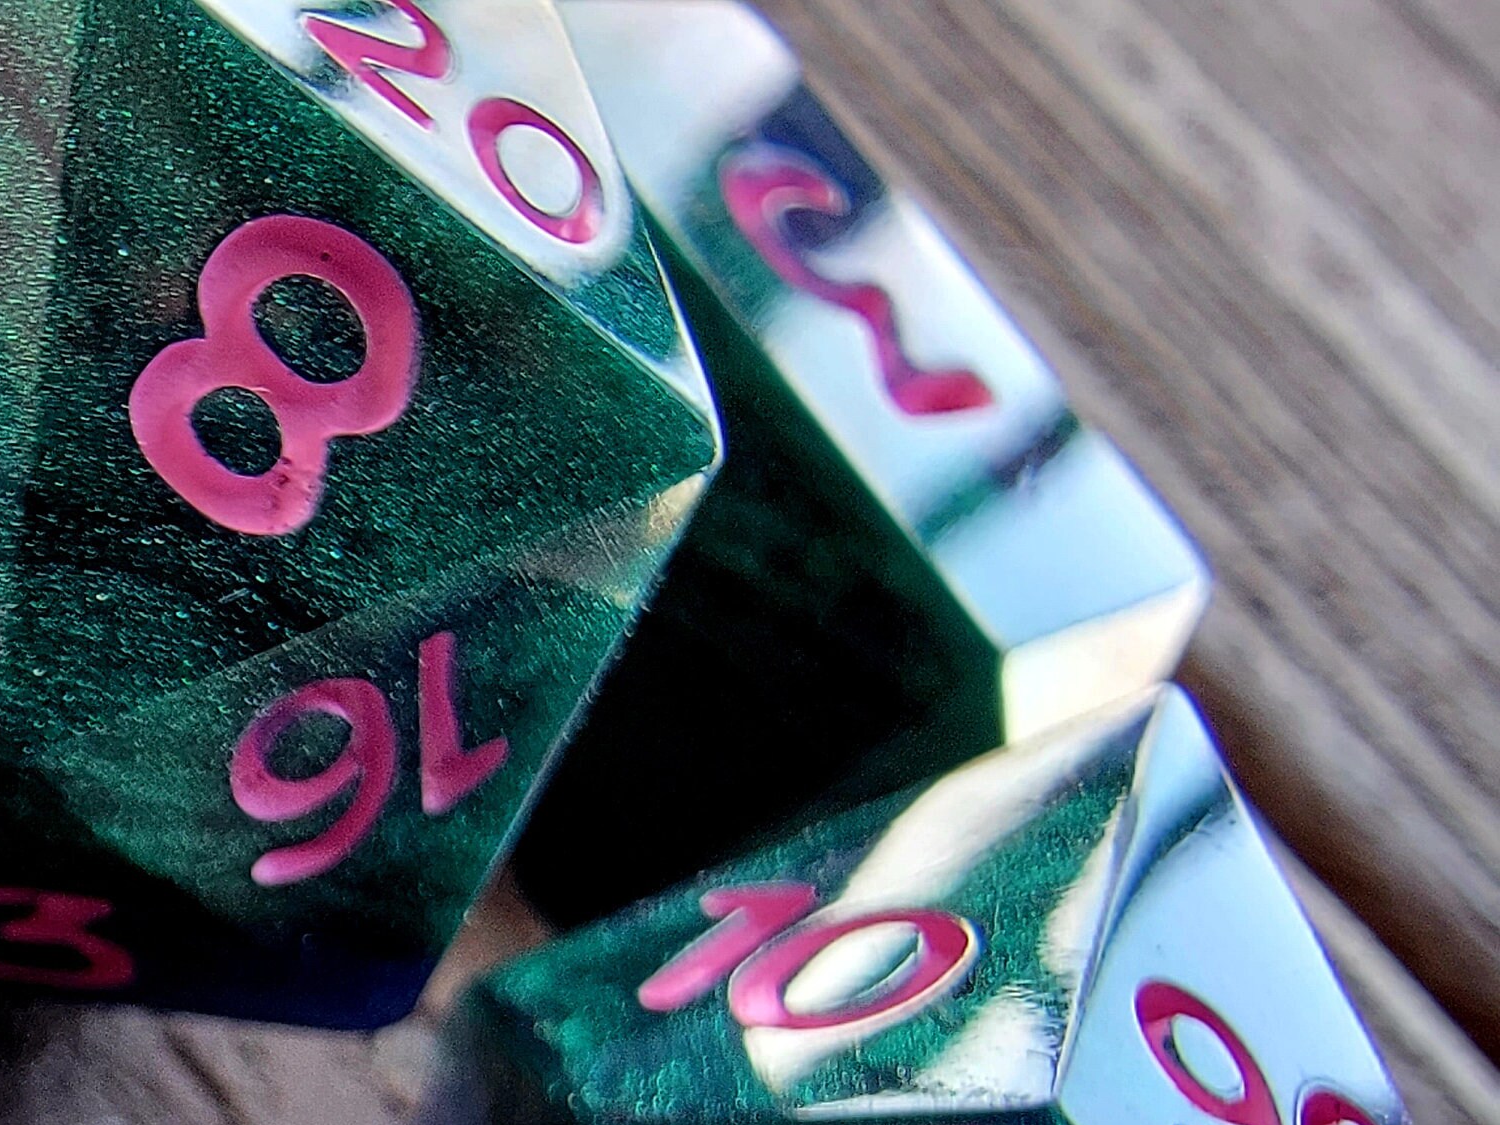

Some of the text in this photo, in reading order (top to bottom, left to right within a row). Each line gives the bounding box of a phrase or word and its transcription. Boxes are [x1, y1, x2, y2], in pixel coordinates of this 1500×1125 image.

[304, 0, 602, 244] 20
[128, 213, 418, 537] 8
[231, 630, 510, 886] 16
[638, 881, 975, 1031] 10
